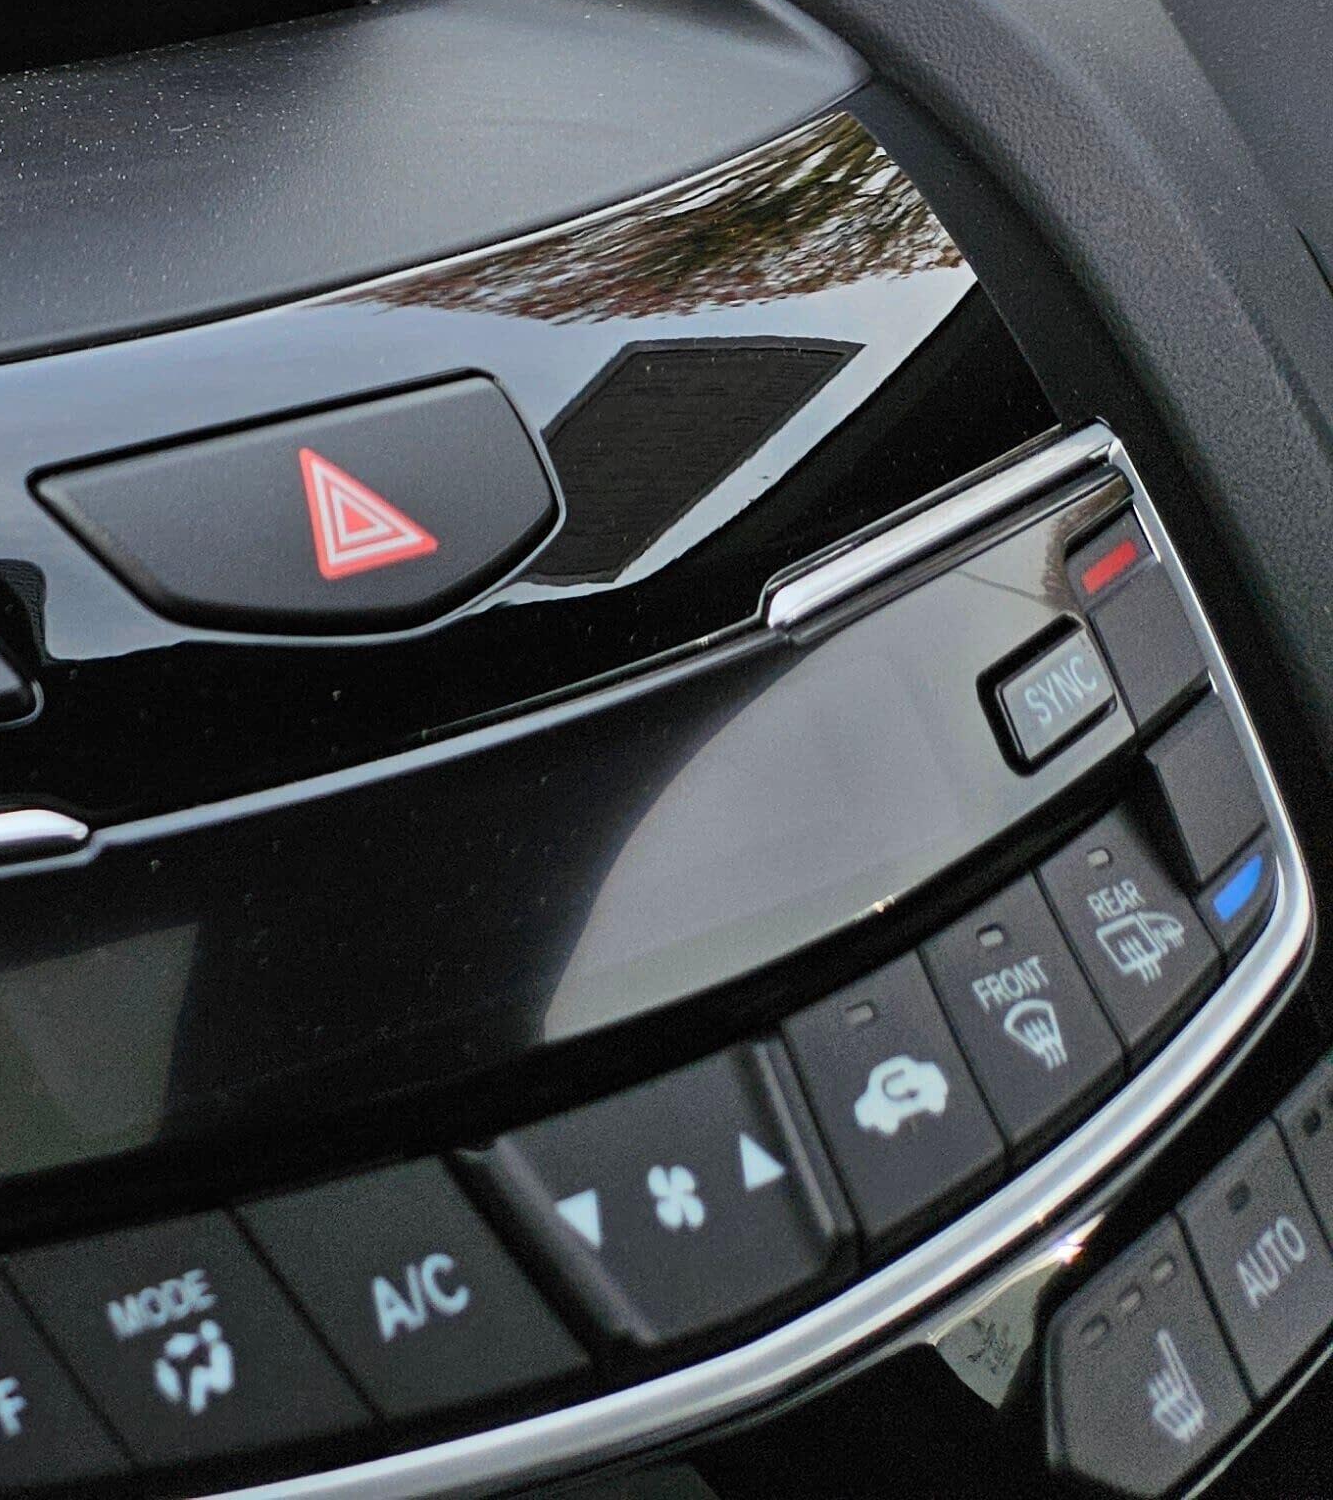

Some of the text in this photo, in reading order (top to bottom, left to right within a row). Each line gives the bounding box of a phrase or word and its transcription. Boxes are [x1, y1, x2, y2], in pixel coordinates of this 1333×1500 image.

[1024, 655, 1099, 725] SYNC
[1086, 879, 1147, 919] REAR
[972, 956, 1049, 1012] FRONT
[372, 1253, 469, 1341] A/C
[1235, 1216, 1307, 1308] AUTO
[106, 1268, 217, 1339] MODE
